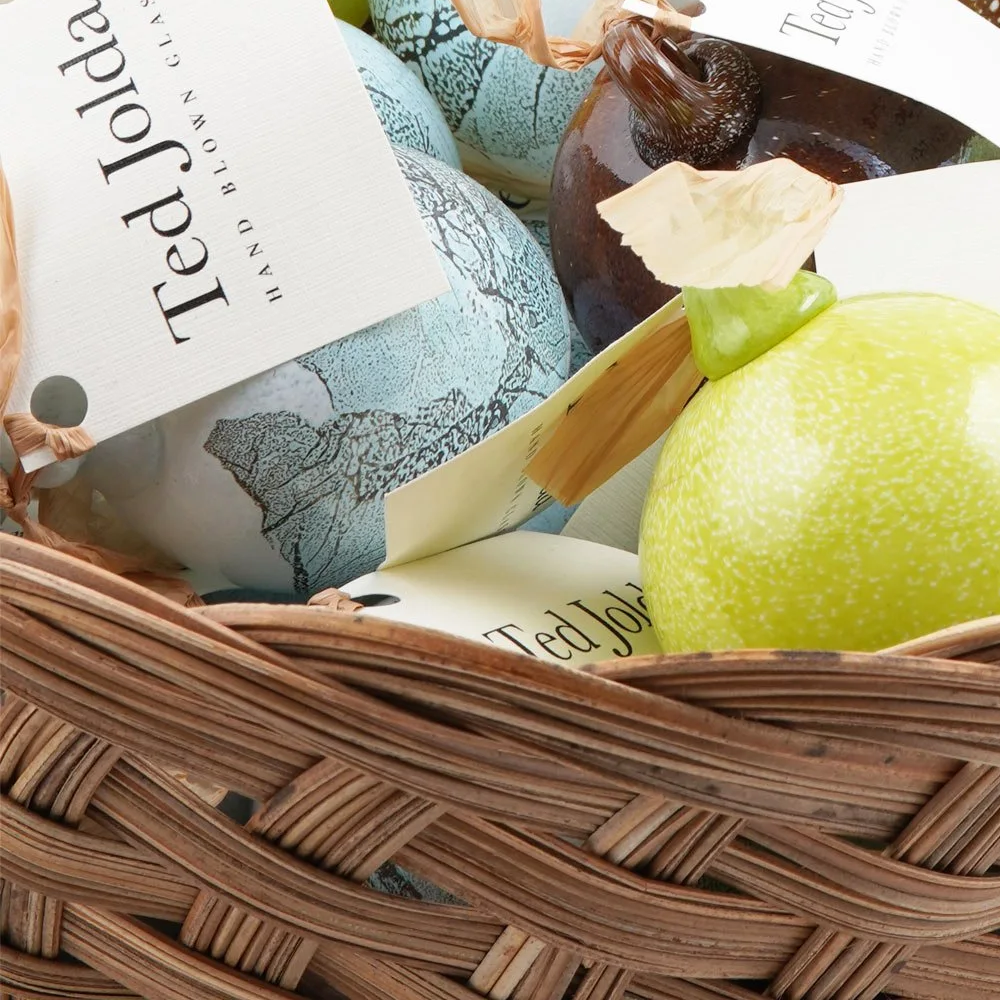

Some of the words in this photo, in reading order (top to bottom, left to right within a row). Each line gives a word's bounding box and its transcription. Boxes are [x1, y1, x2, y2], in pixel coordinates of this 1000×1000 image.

[179, 89, 238, 197] BLOWN
[119, 185, 231, 345] Ted
[236, 218, 284, 304] HAND
[481, 609, 602, 661] Ted
[565, 582, 653, 659] Jol
